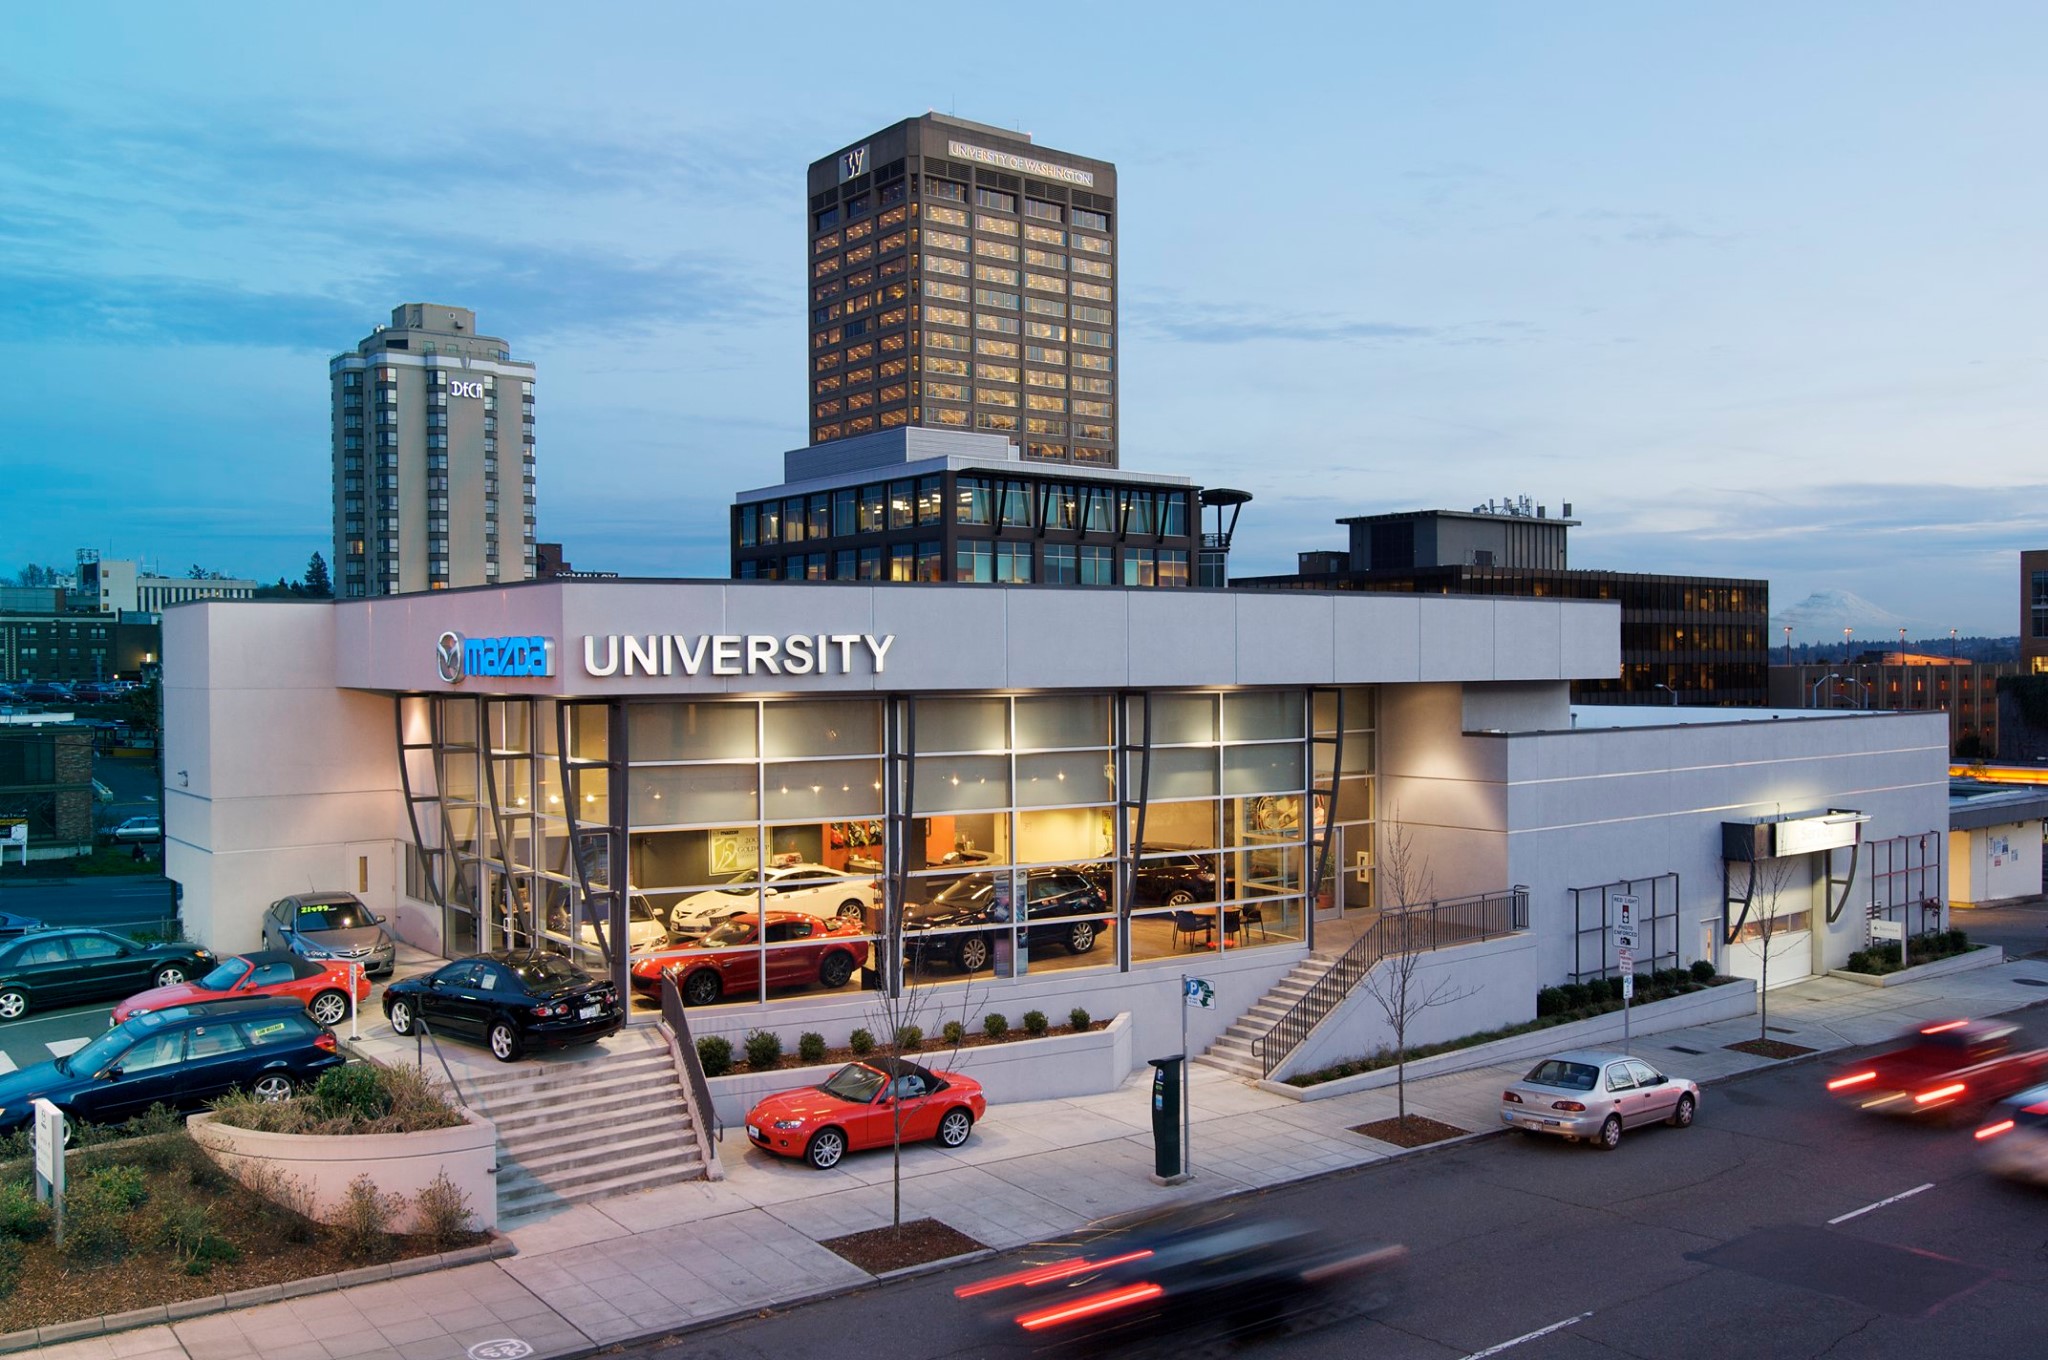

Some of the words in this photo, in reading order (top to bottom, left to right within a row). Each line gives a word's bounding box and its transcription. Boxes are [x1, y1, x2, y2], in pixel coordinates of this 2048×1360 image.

[845, 148, 865, 178] W
[951, 142, 1008, 166] UNIVERSITY
[1009, 155, 1024, 168] OF
[1024, 159, 1092, 185] WASHINGTON
[451, 381, 483, 399] DECA
[582, 634, 896, 676] UNIVERSITY
[1190, 982, 1198, 994] P
[1157, 1068, 1164, 1080] P
